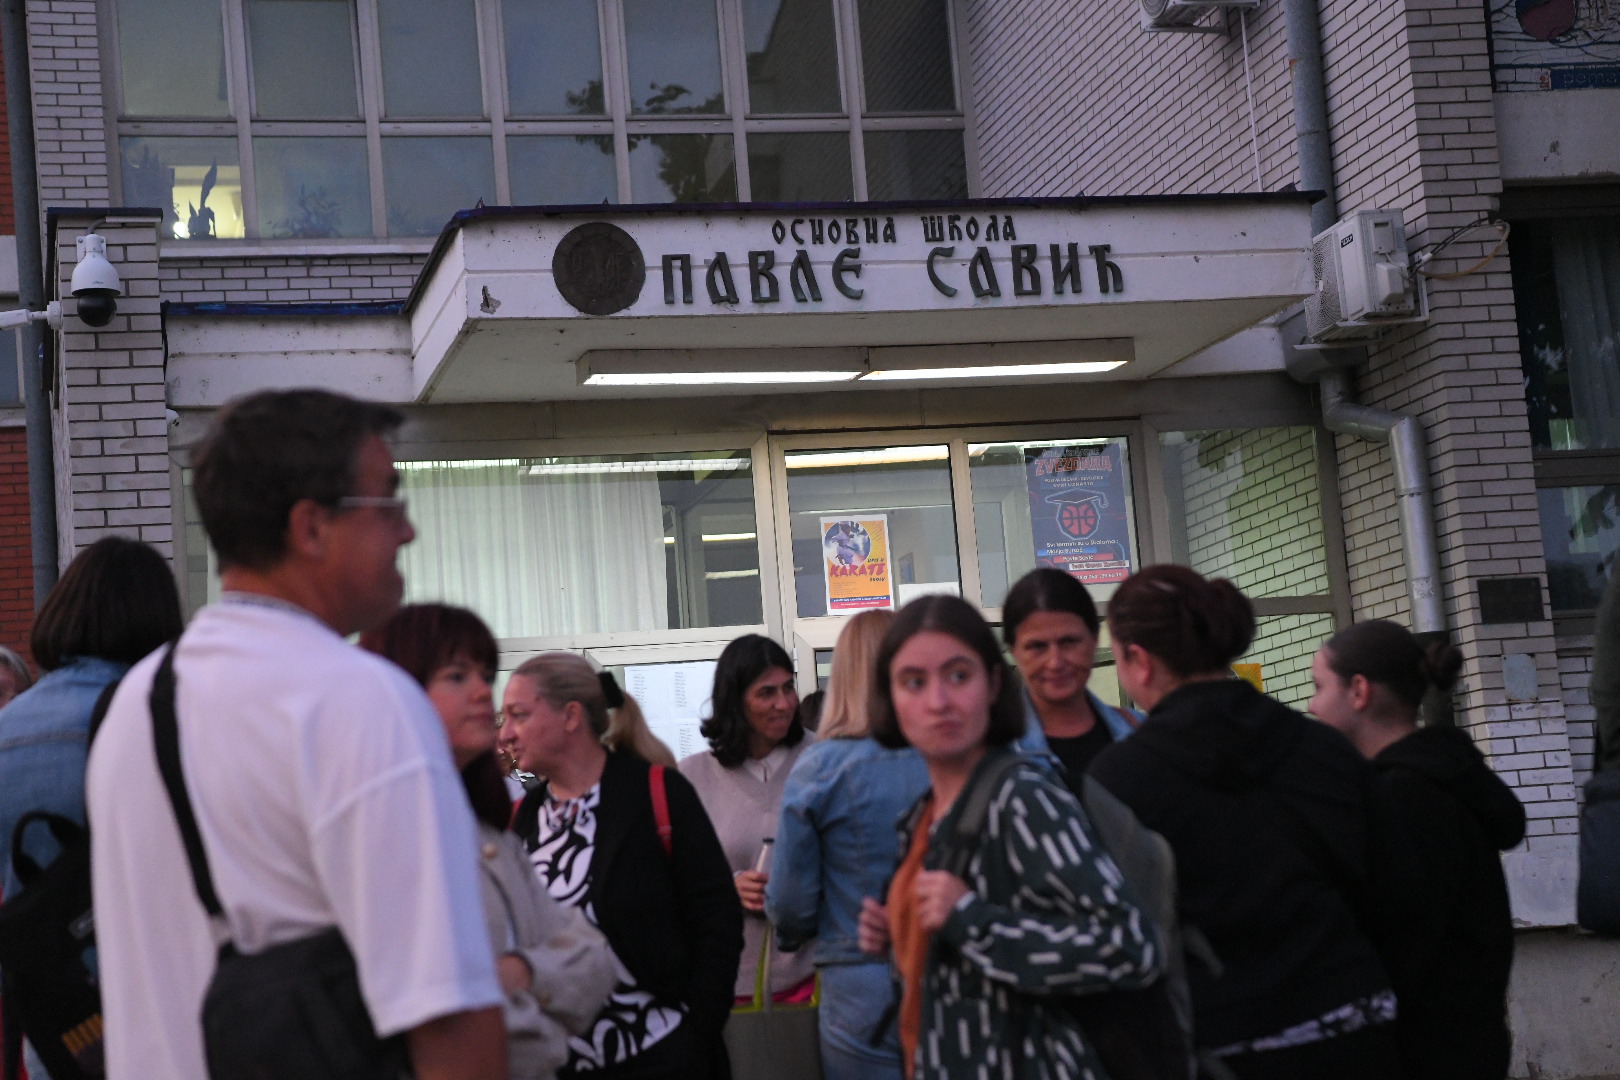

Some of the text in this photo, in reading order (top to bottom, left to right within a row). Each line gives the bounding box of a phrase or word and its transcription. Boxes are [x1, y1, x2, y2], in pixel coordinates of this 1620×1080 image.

[771, 214, 1017, 245] ОСНОВНА ШКОЛА
[926, 242, 1124, 298] САВИЋ
[1035, 456, 1112, 476] ZVEZDARA
